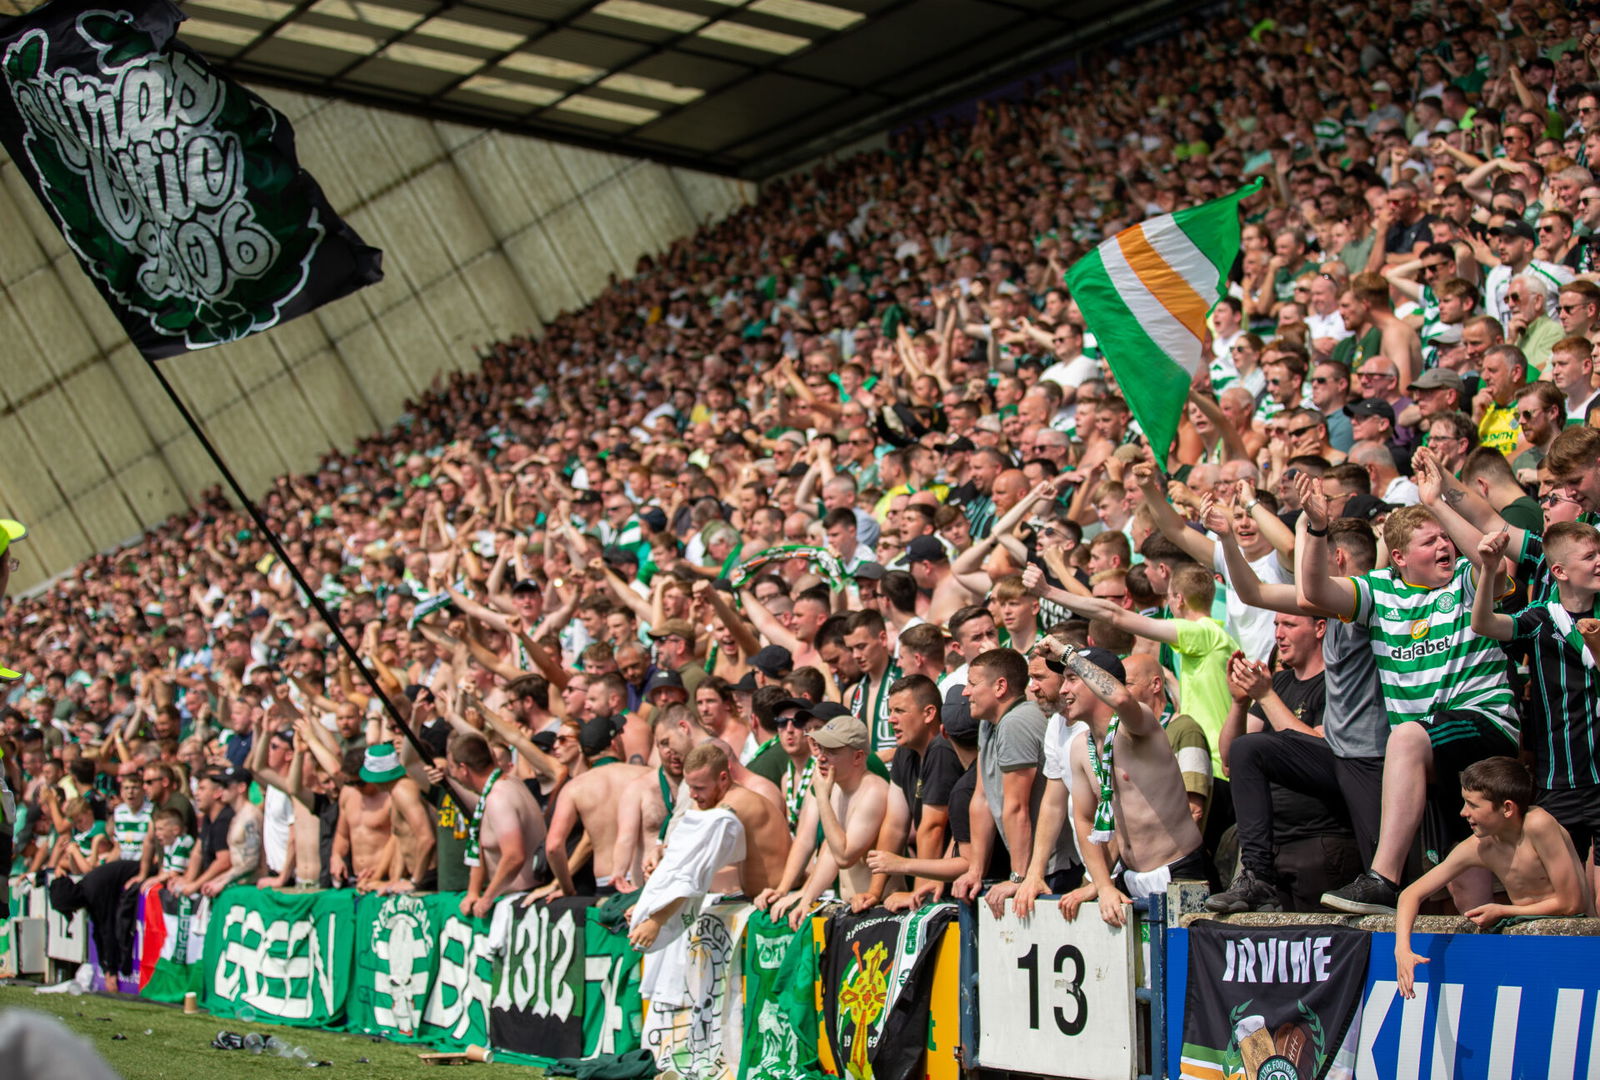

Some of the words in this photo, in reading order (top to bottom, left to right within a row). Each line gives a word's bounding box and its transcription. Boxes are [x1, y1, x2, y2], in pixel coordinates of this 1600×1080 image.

[1391, 636, 1450, 660] dafabet
[215, 905, 336, 1019] GREEN
[492, 904, 576, 1024] 1312
[1018, 944, 1088, 1036] 13
[1222, 936, 1333, 984] IRVINE
[843, 1035, 852, 1047] 19
[867, 1036, 878, 1048] 69
